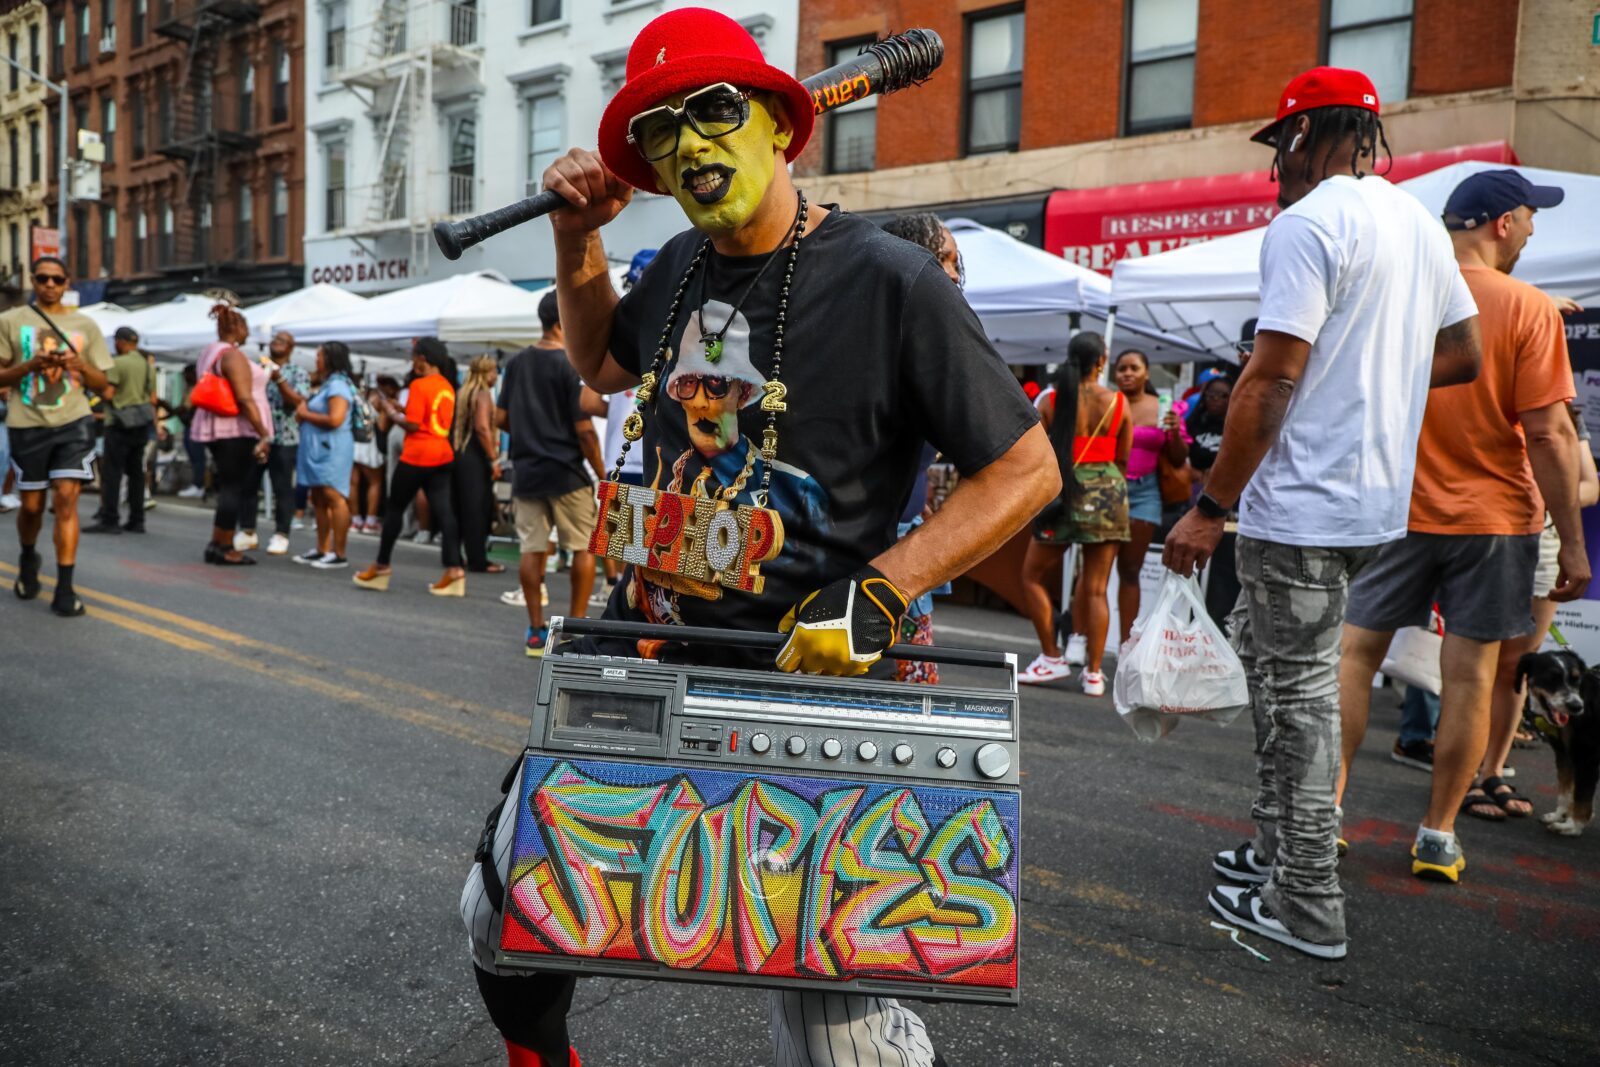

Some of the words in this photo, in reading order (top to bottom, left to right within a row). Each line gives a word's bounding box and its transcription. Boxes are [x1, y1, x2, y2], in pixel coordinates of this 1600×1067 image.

[1110, 208, 1240, 236] RESPECT
[1247, 206, 1275, 224] FO
[312, 264, 354, 285] GOOD
[357, 258, 409, 282] BATCH
[964, 703, 1004, 714] MAGNAVOX
